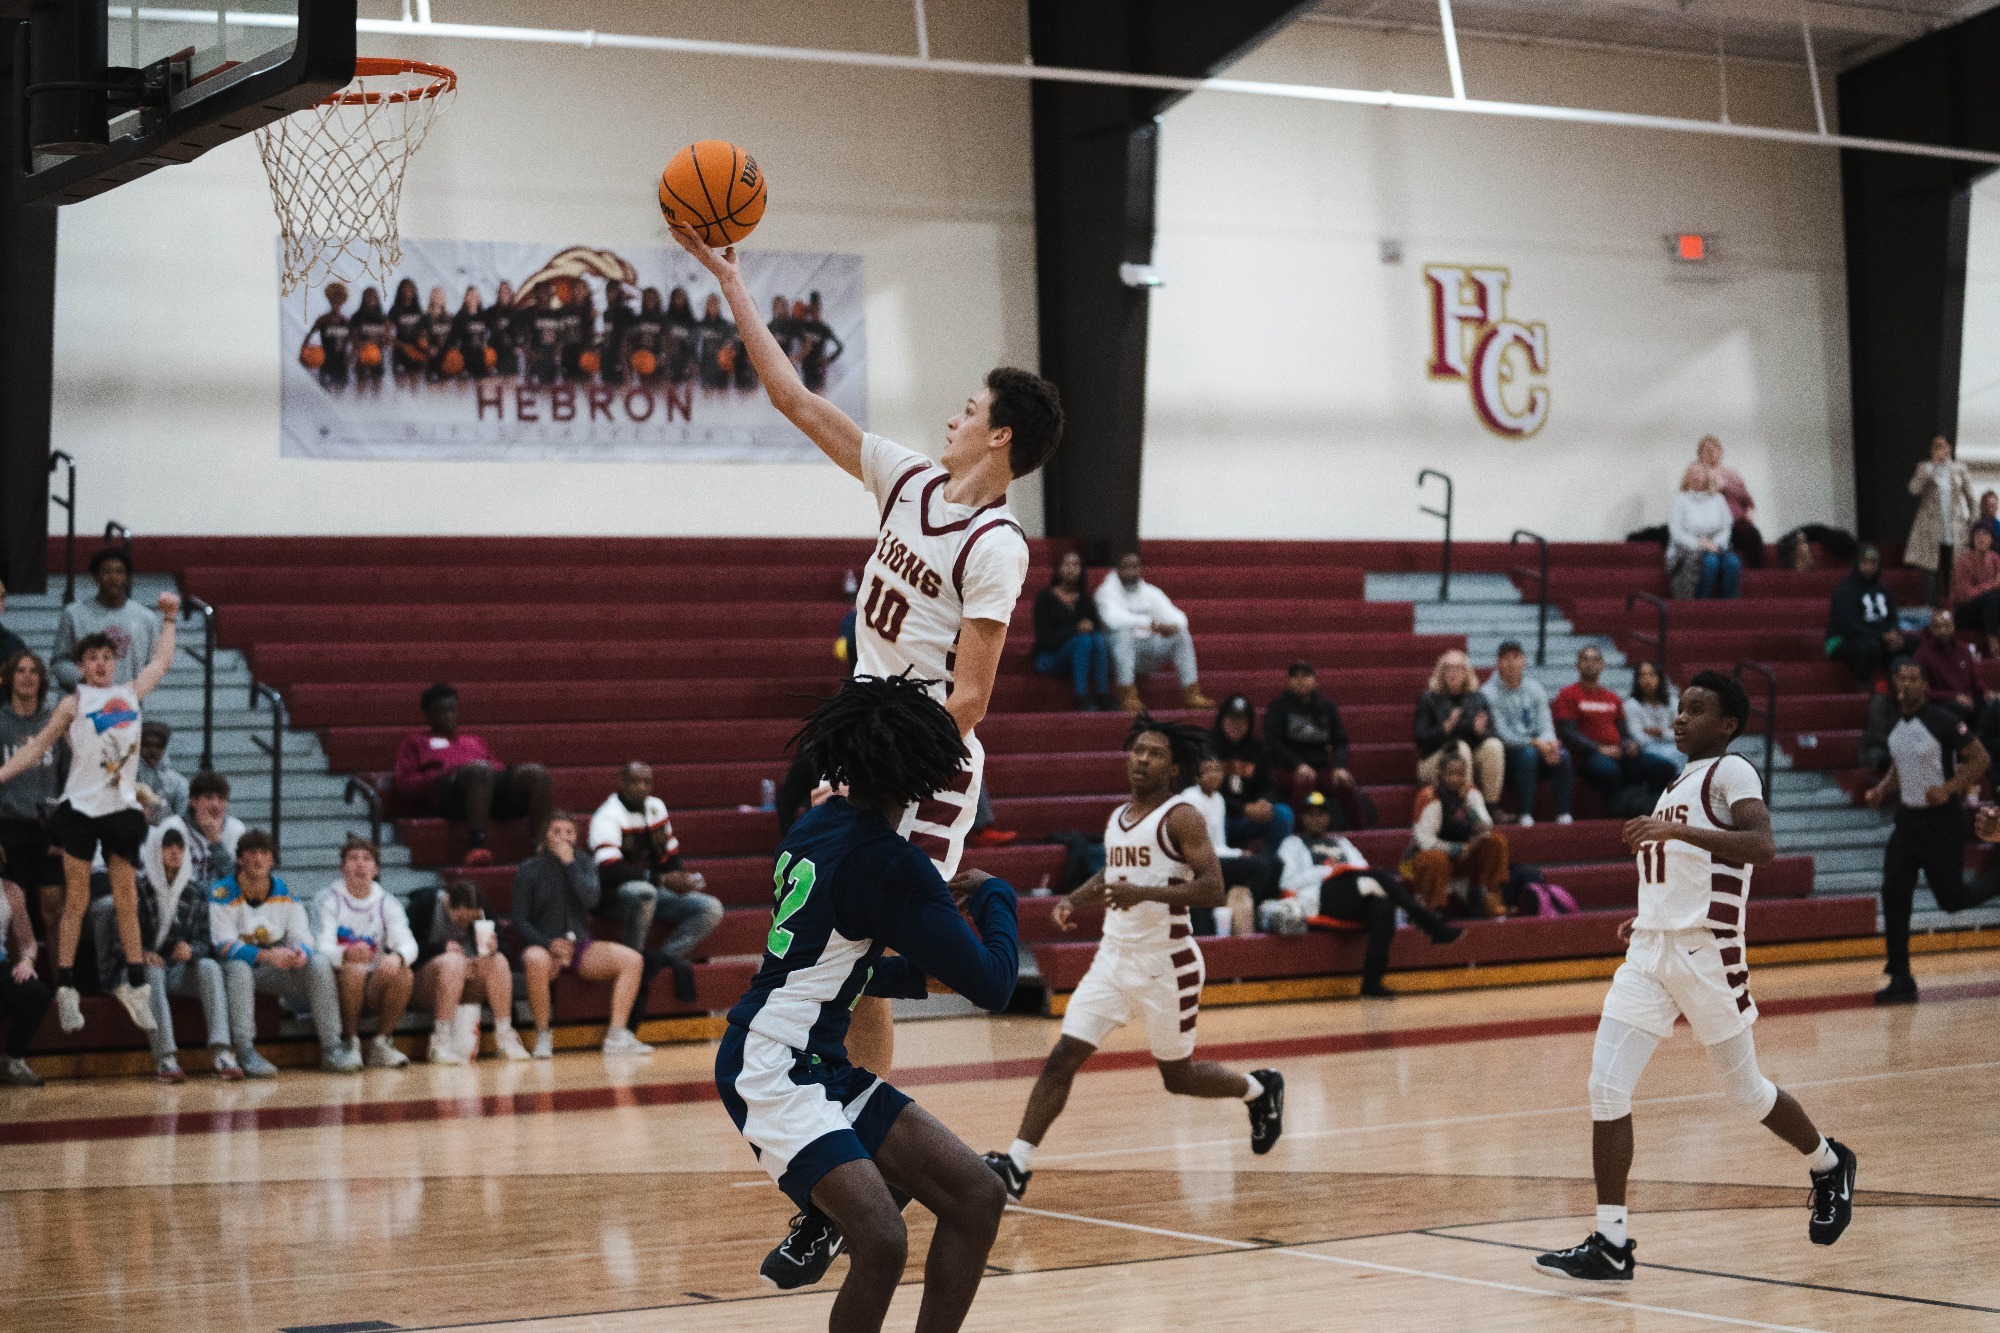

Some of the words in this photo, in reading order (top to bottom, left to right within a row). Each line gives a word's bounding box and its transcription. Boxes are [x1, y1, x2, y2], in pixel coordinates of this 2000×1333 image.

[1423, 262, 1551, 441] HC
[476, 384, 692, 423] HEBRON
[877, 529, 943, 599] LIONS
[863, 574, 911, 643] 10
[1107, 845, 1152, 868] IONS
[1642, 841, 1666, 885] 11
